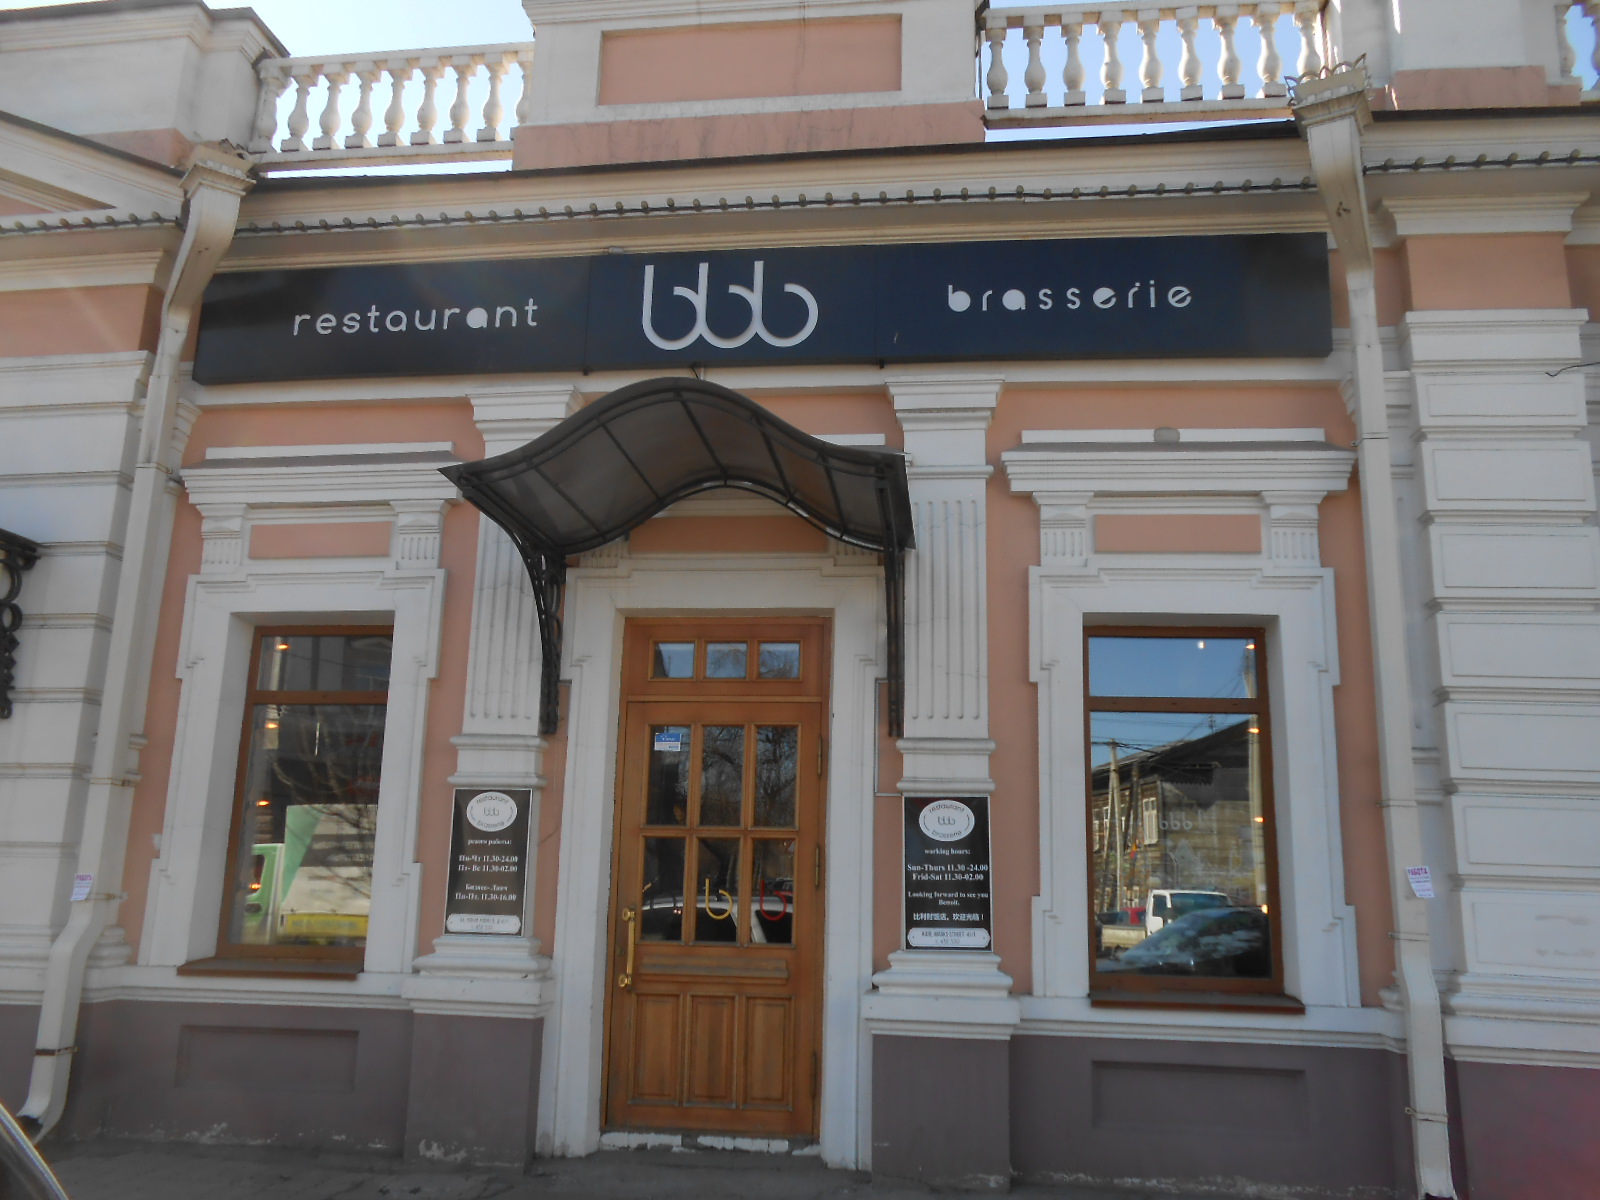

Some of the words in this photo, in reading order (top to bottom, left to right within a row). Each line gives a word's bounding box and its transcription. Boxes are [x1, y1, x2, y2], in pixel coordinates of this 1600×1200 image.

[642, 260, 819, 351] bbb
[948, 280, 1192, 312] brasserie
[293, 298, 538, 336] restaurant
[924, 848, 950, 856] working
[908, 891, 933, 899] Looking
